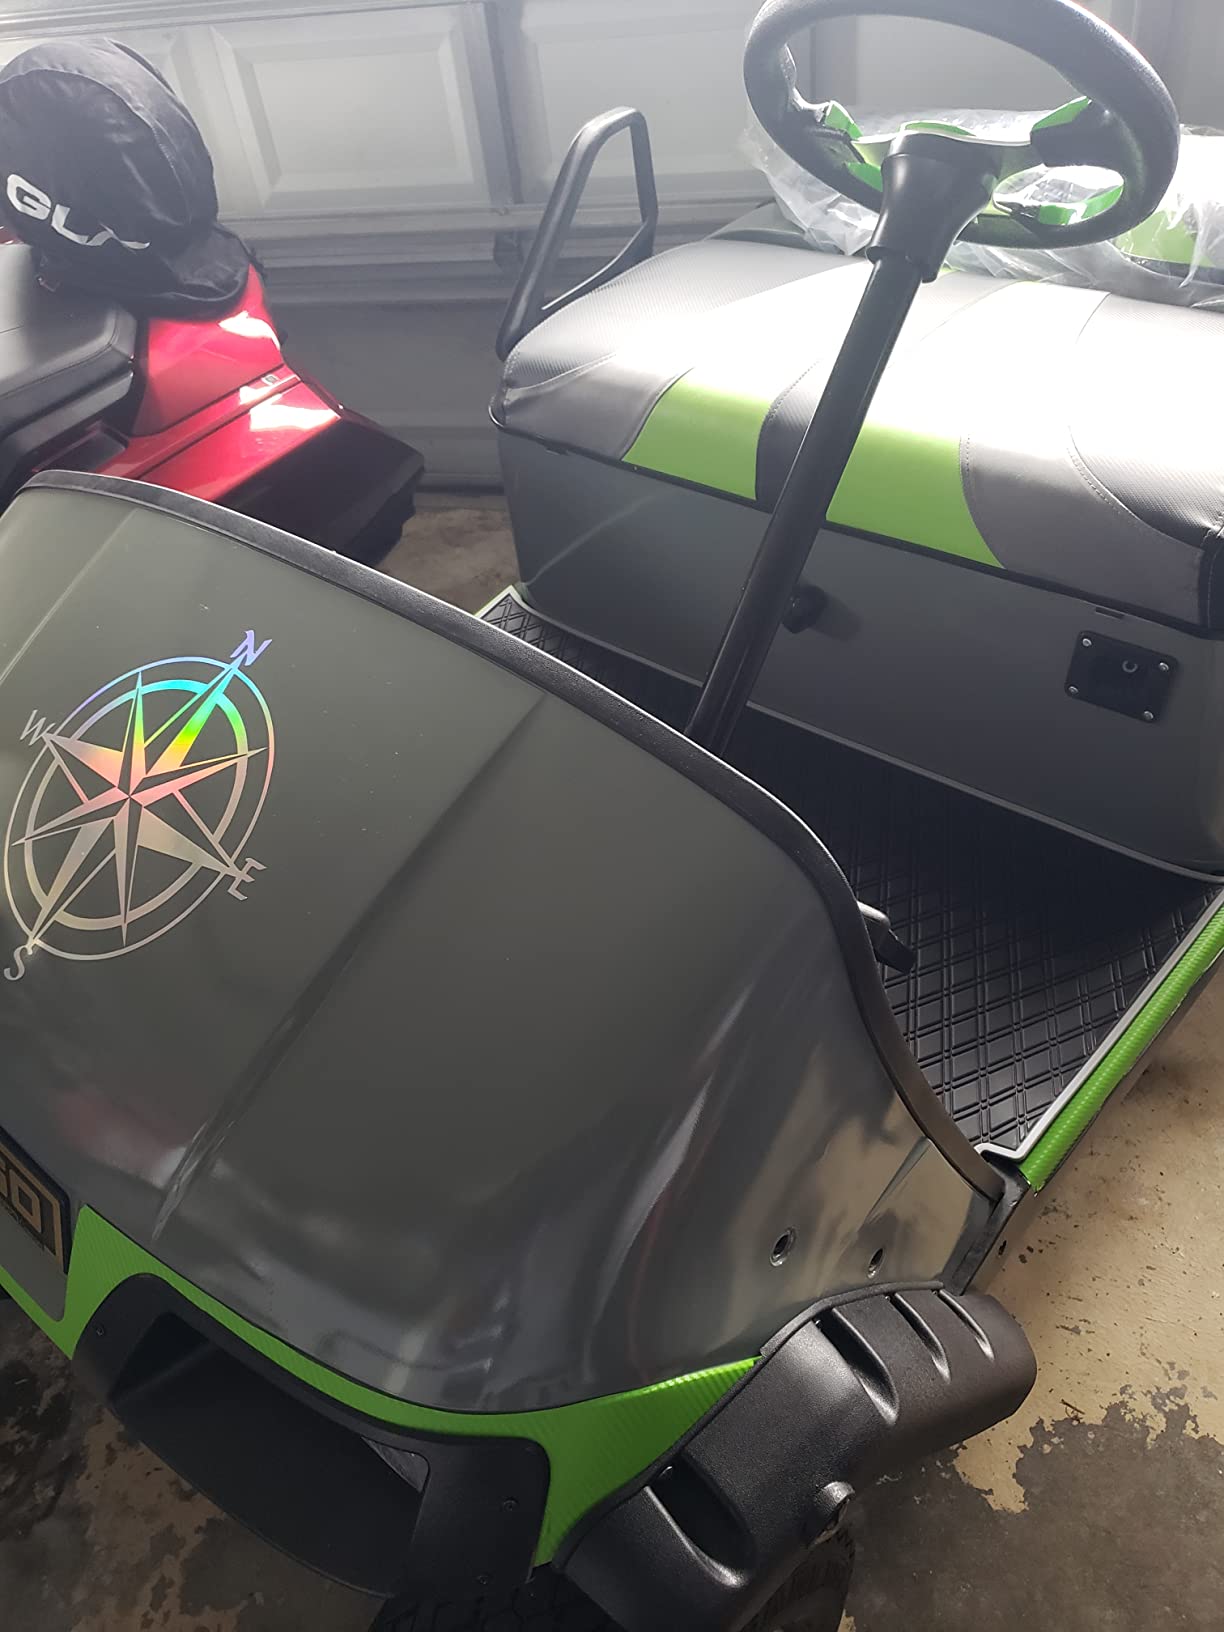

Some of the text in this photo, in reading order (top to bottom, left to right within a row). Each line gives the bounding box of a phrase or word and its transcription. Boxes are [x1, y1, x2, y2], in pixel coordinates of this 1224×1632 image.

[230, 629, 273, 666] N
[19, 709, 56, 746] W
[227, 857, 267, 901] E
[3, 944, 33, 981] S
[0, 1157, 43, 1234] O
